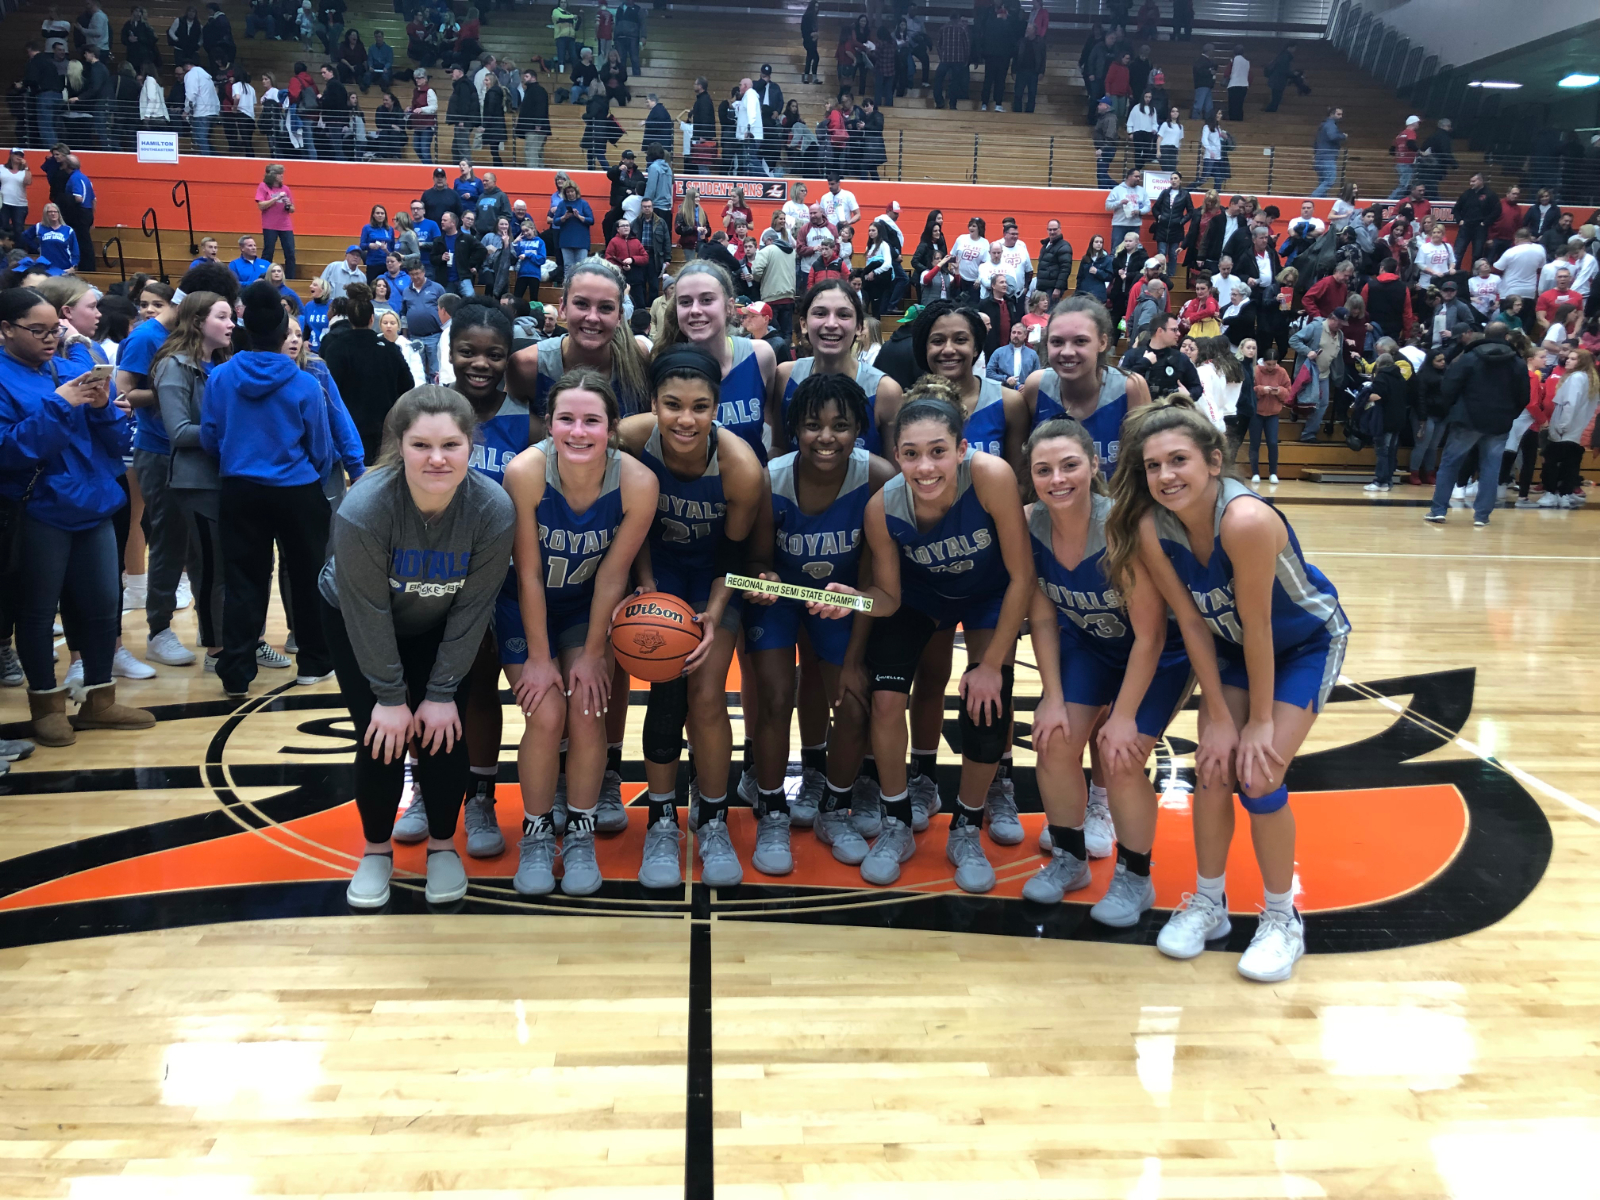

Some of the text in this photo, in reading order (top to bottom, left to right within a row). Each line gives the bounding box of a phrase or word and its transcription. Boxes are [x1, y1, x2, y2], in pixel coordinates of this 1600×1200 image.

[686, 181, 735, 196] STUDENT
[962, 249, 980, 262] CP
[716, 398, 761, 426] ALS
[468, 443, 517, 474] ALS
[726, 576, 764, 591] REGIONAL
[765, 584, 779, 593] and
[780, 585, 799, 597] SEMI
[800, 589, 823, 601] STATE
[625, 602, 684, 625] Wilson
